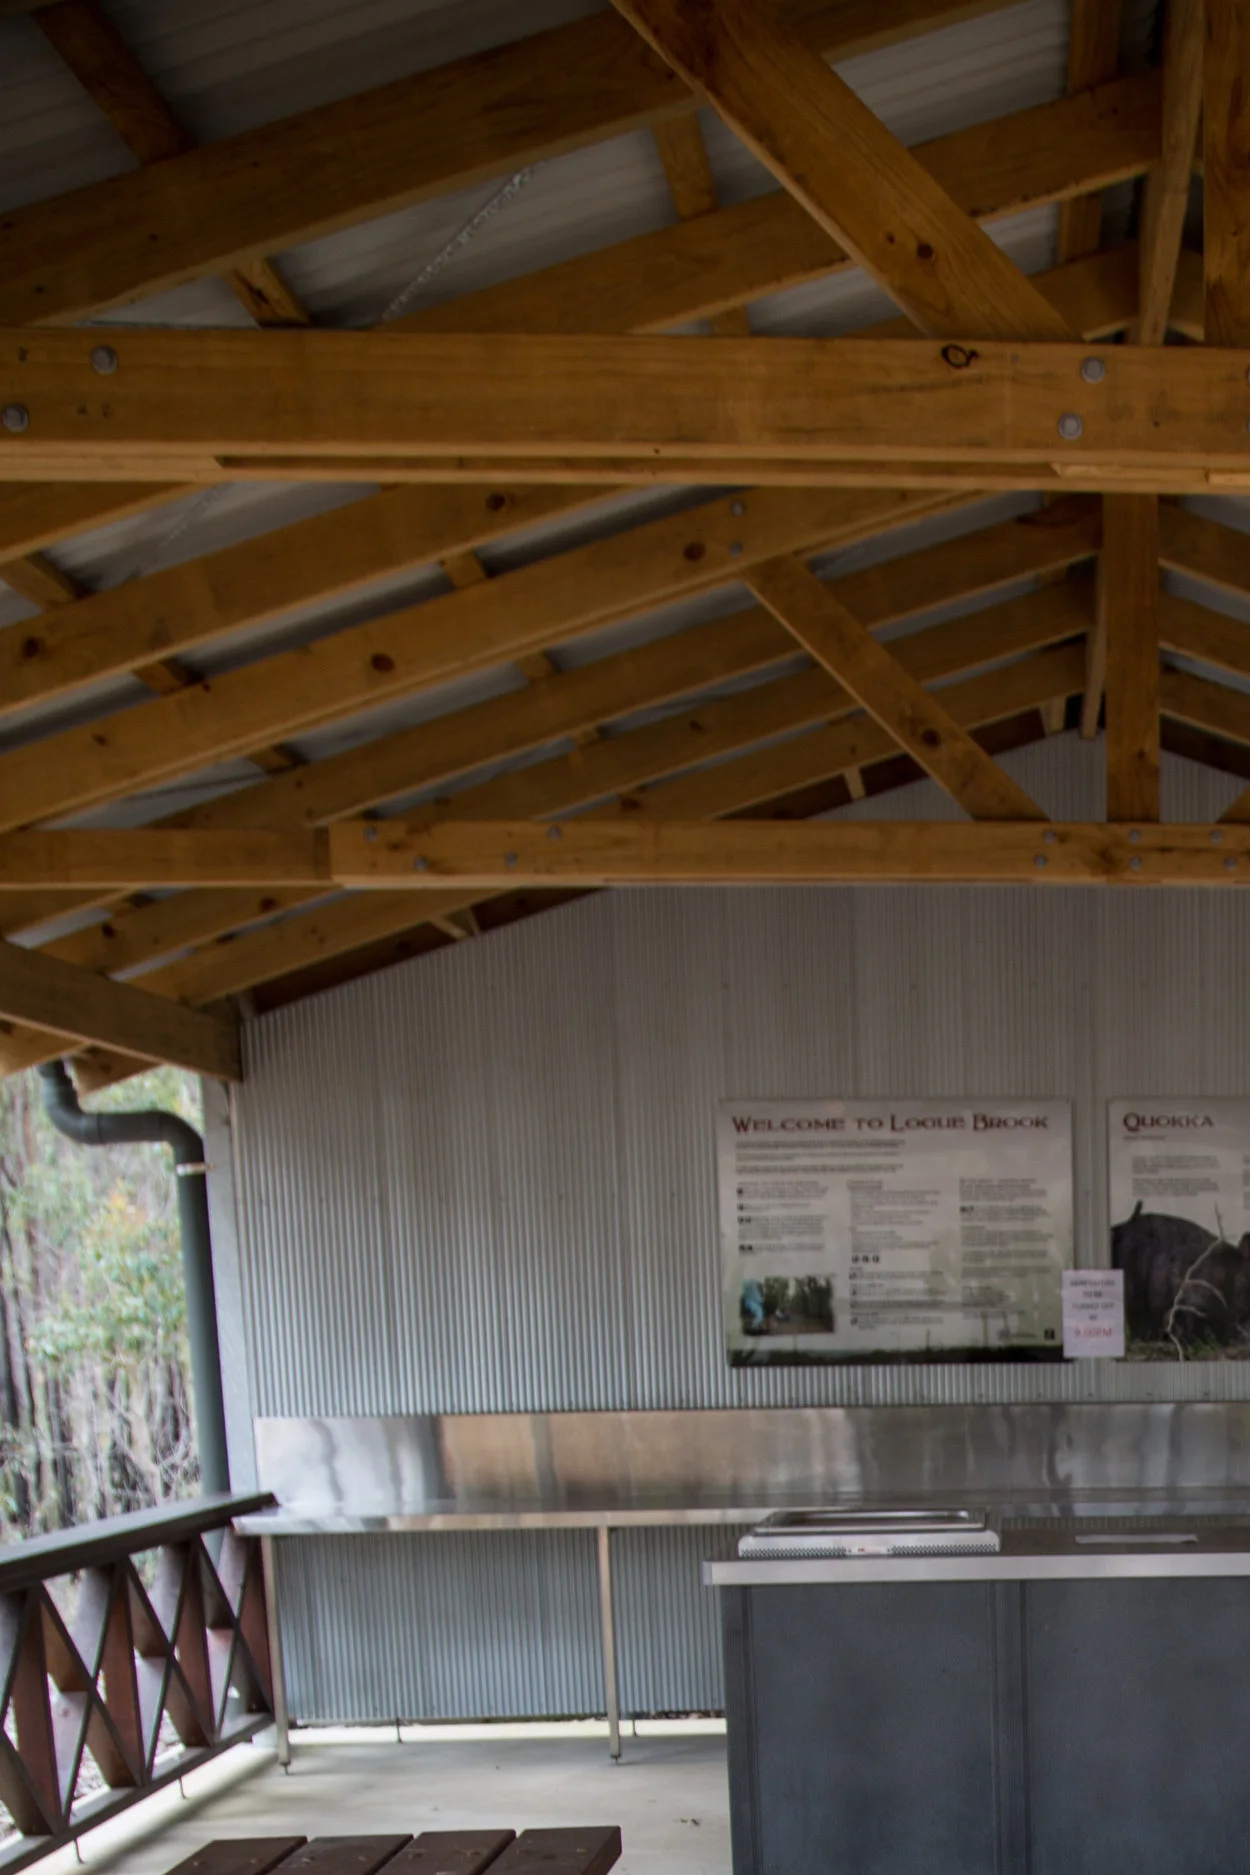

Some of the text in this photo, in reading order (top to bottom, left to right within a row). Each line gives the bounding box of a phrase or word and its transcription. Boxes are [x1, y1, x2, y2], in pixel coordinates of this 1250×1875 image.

[732, 1112, 1049, 1134] WELCOME TO LOGUE BROOK
[1123, 1112, 1215, 1133] QUOKKA
